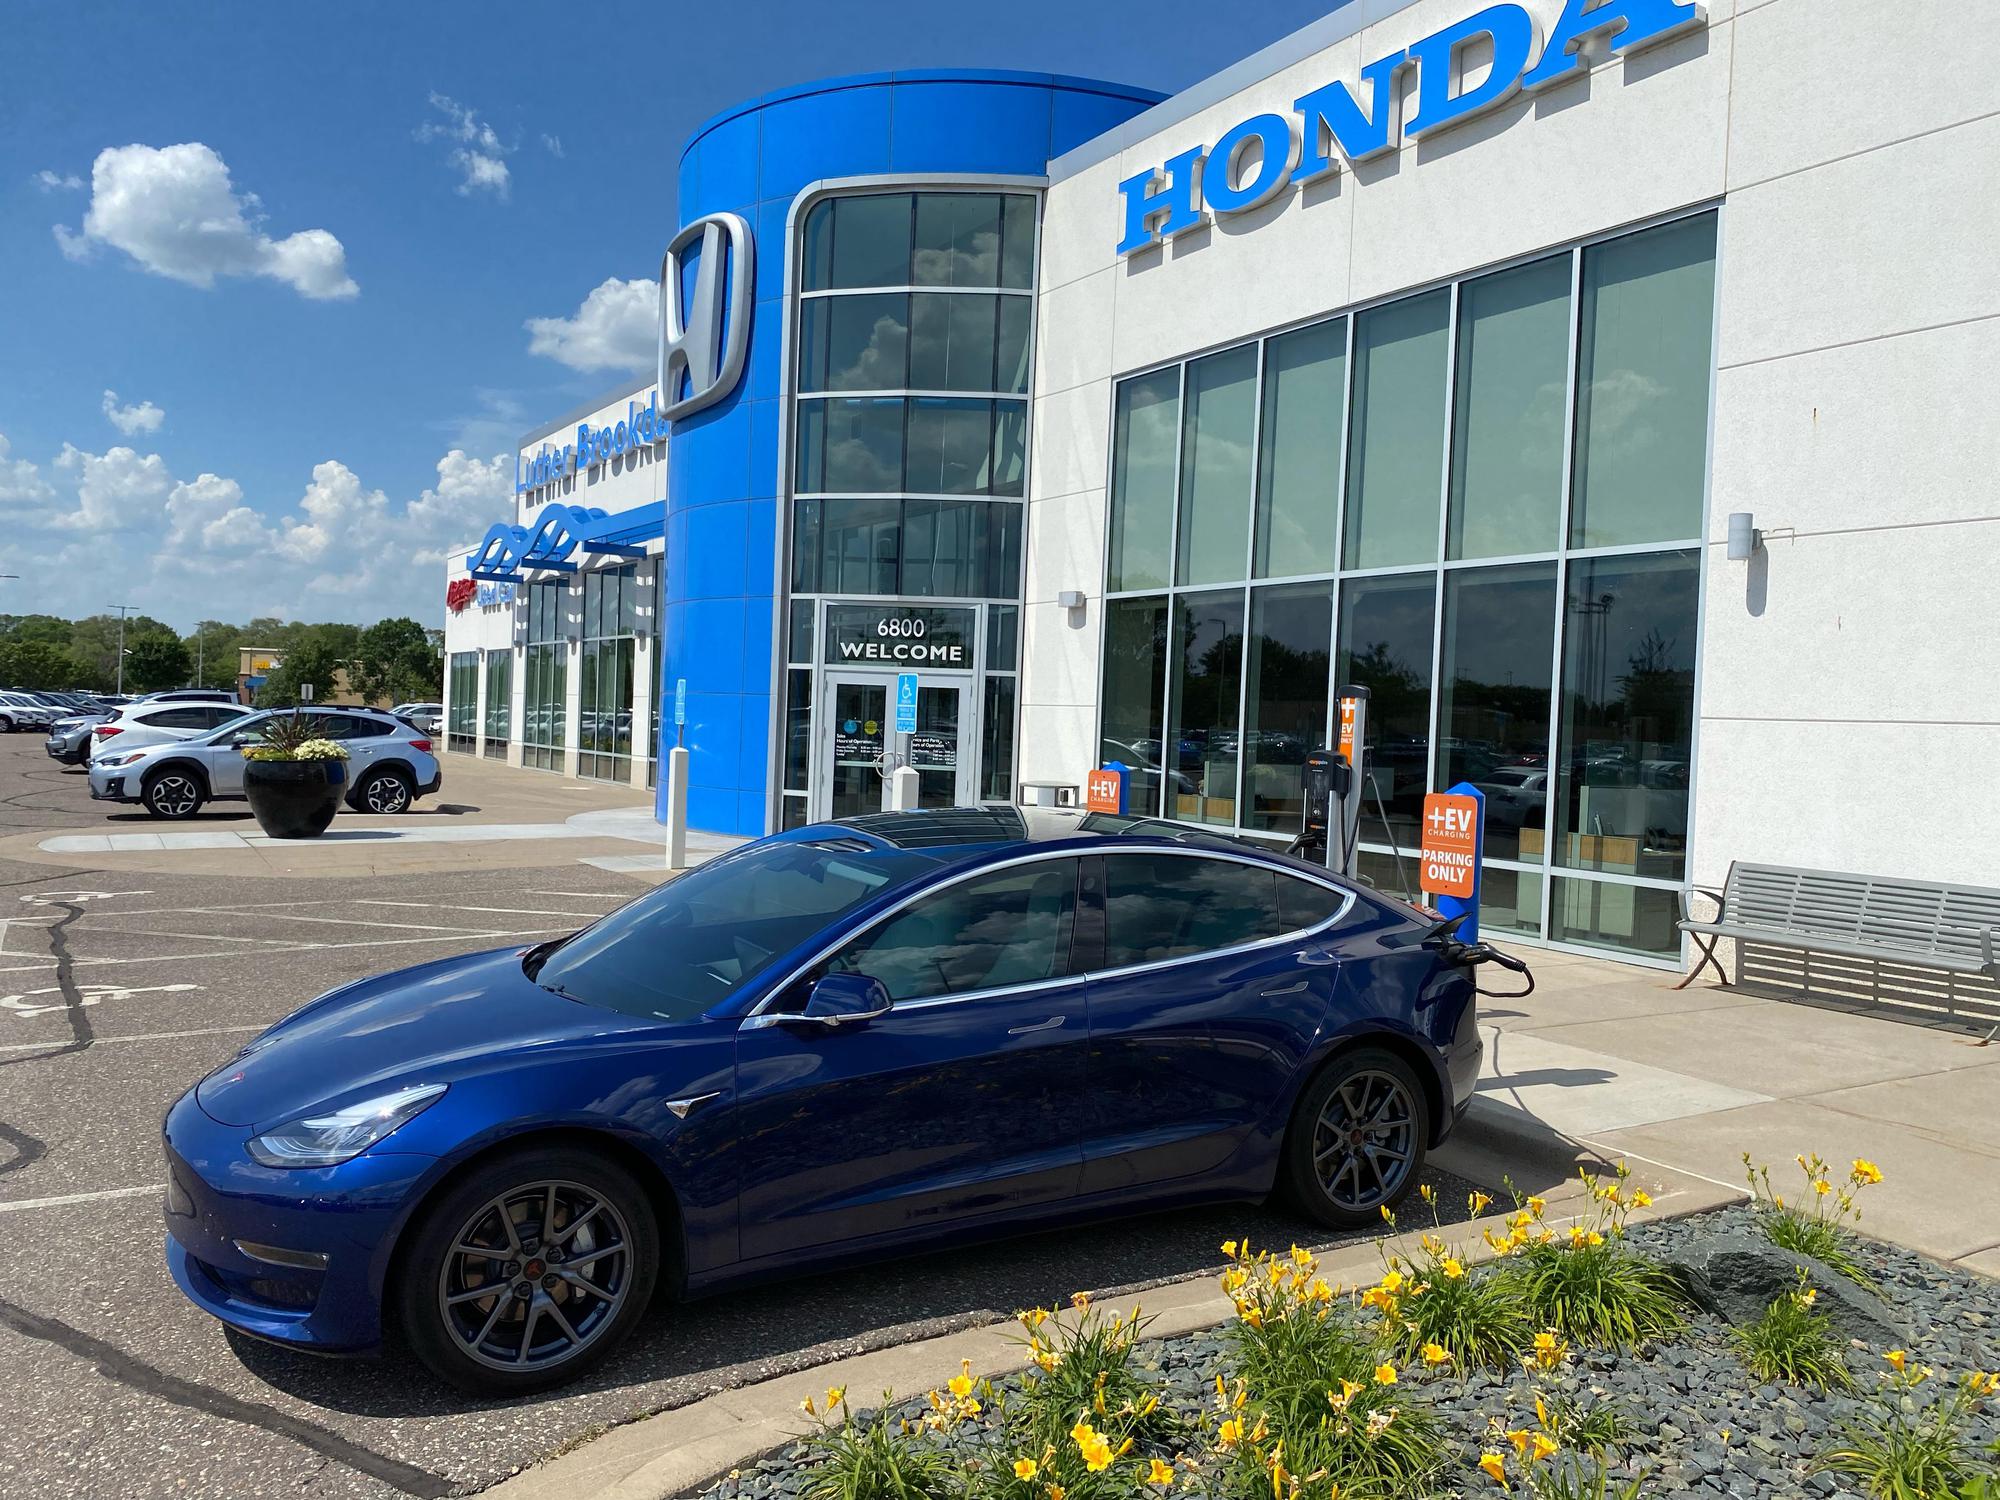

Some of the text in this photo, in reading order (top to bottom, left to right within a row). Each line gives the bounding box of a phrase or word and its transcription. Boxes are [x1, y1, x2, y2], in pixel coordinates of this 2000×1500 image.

[1118, 0, 1698, 257] HONDA
[516, 443, 572, 493] Luther
[877, 618, 925, 637] 6800
[840, 642, 962, 661] WELCOME
[1341, 723, 1353, 734] EV
[1427, 828, 1471, 840] CHARGING
[1422, 849, 1473, 867] PARKING
[1427, 864, 1467, 884] ONLY
